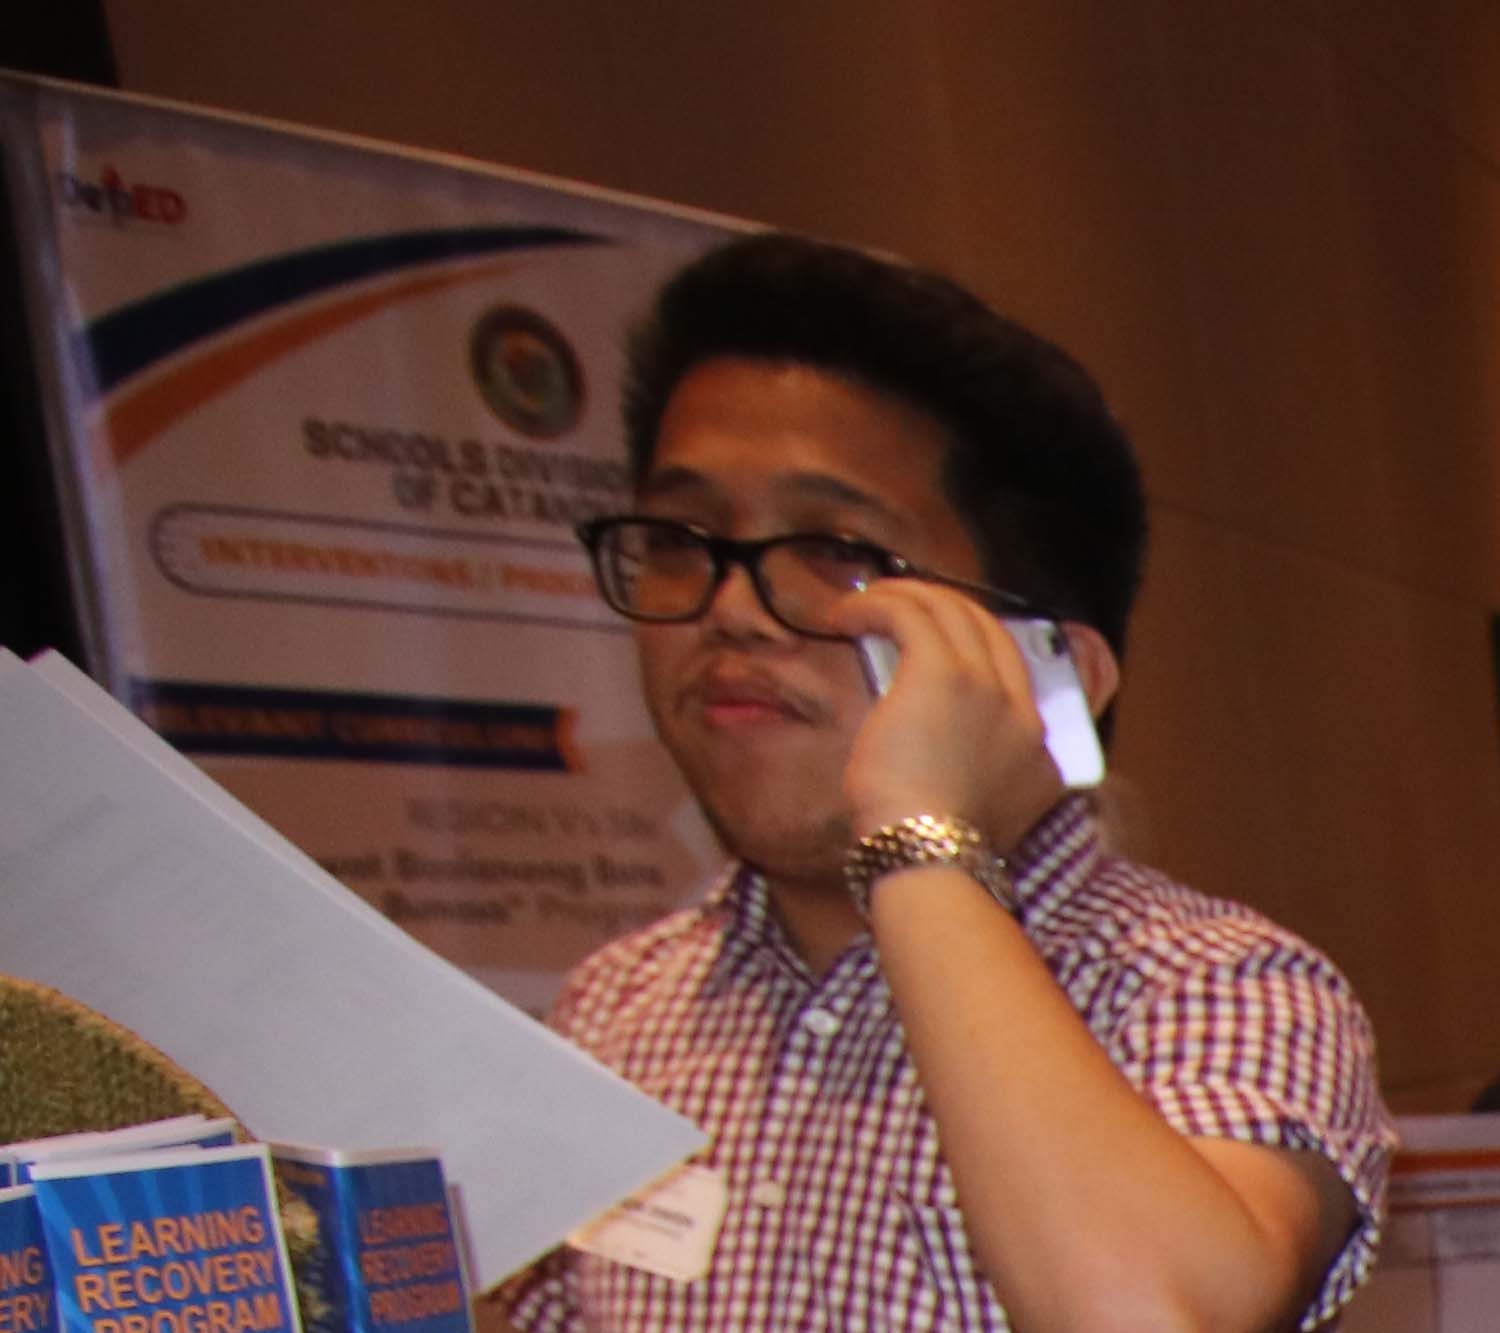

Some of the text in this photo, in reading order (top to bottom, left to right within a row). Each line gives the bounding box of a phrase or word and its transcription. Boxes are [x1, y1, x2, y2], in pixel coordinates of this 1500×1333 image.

[302, 417, 486, 475] SCHOOLS
[70, 1203, 266, 1268] LEARNING
[357, 1202, 449, 1244] LEARNING
[75, 1247, 280, 1313] RECOVERY
